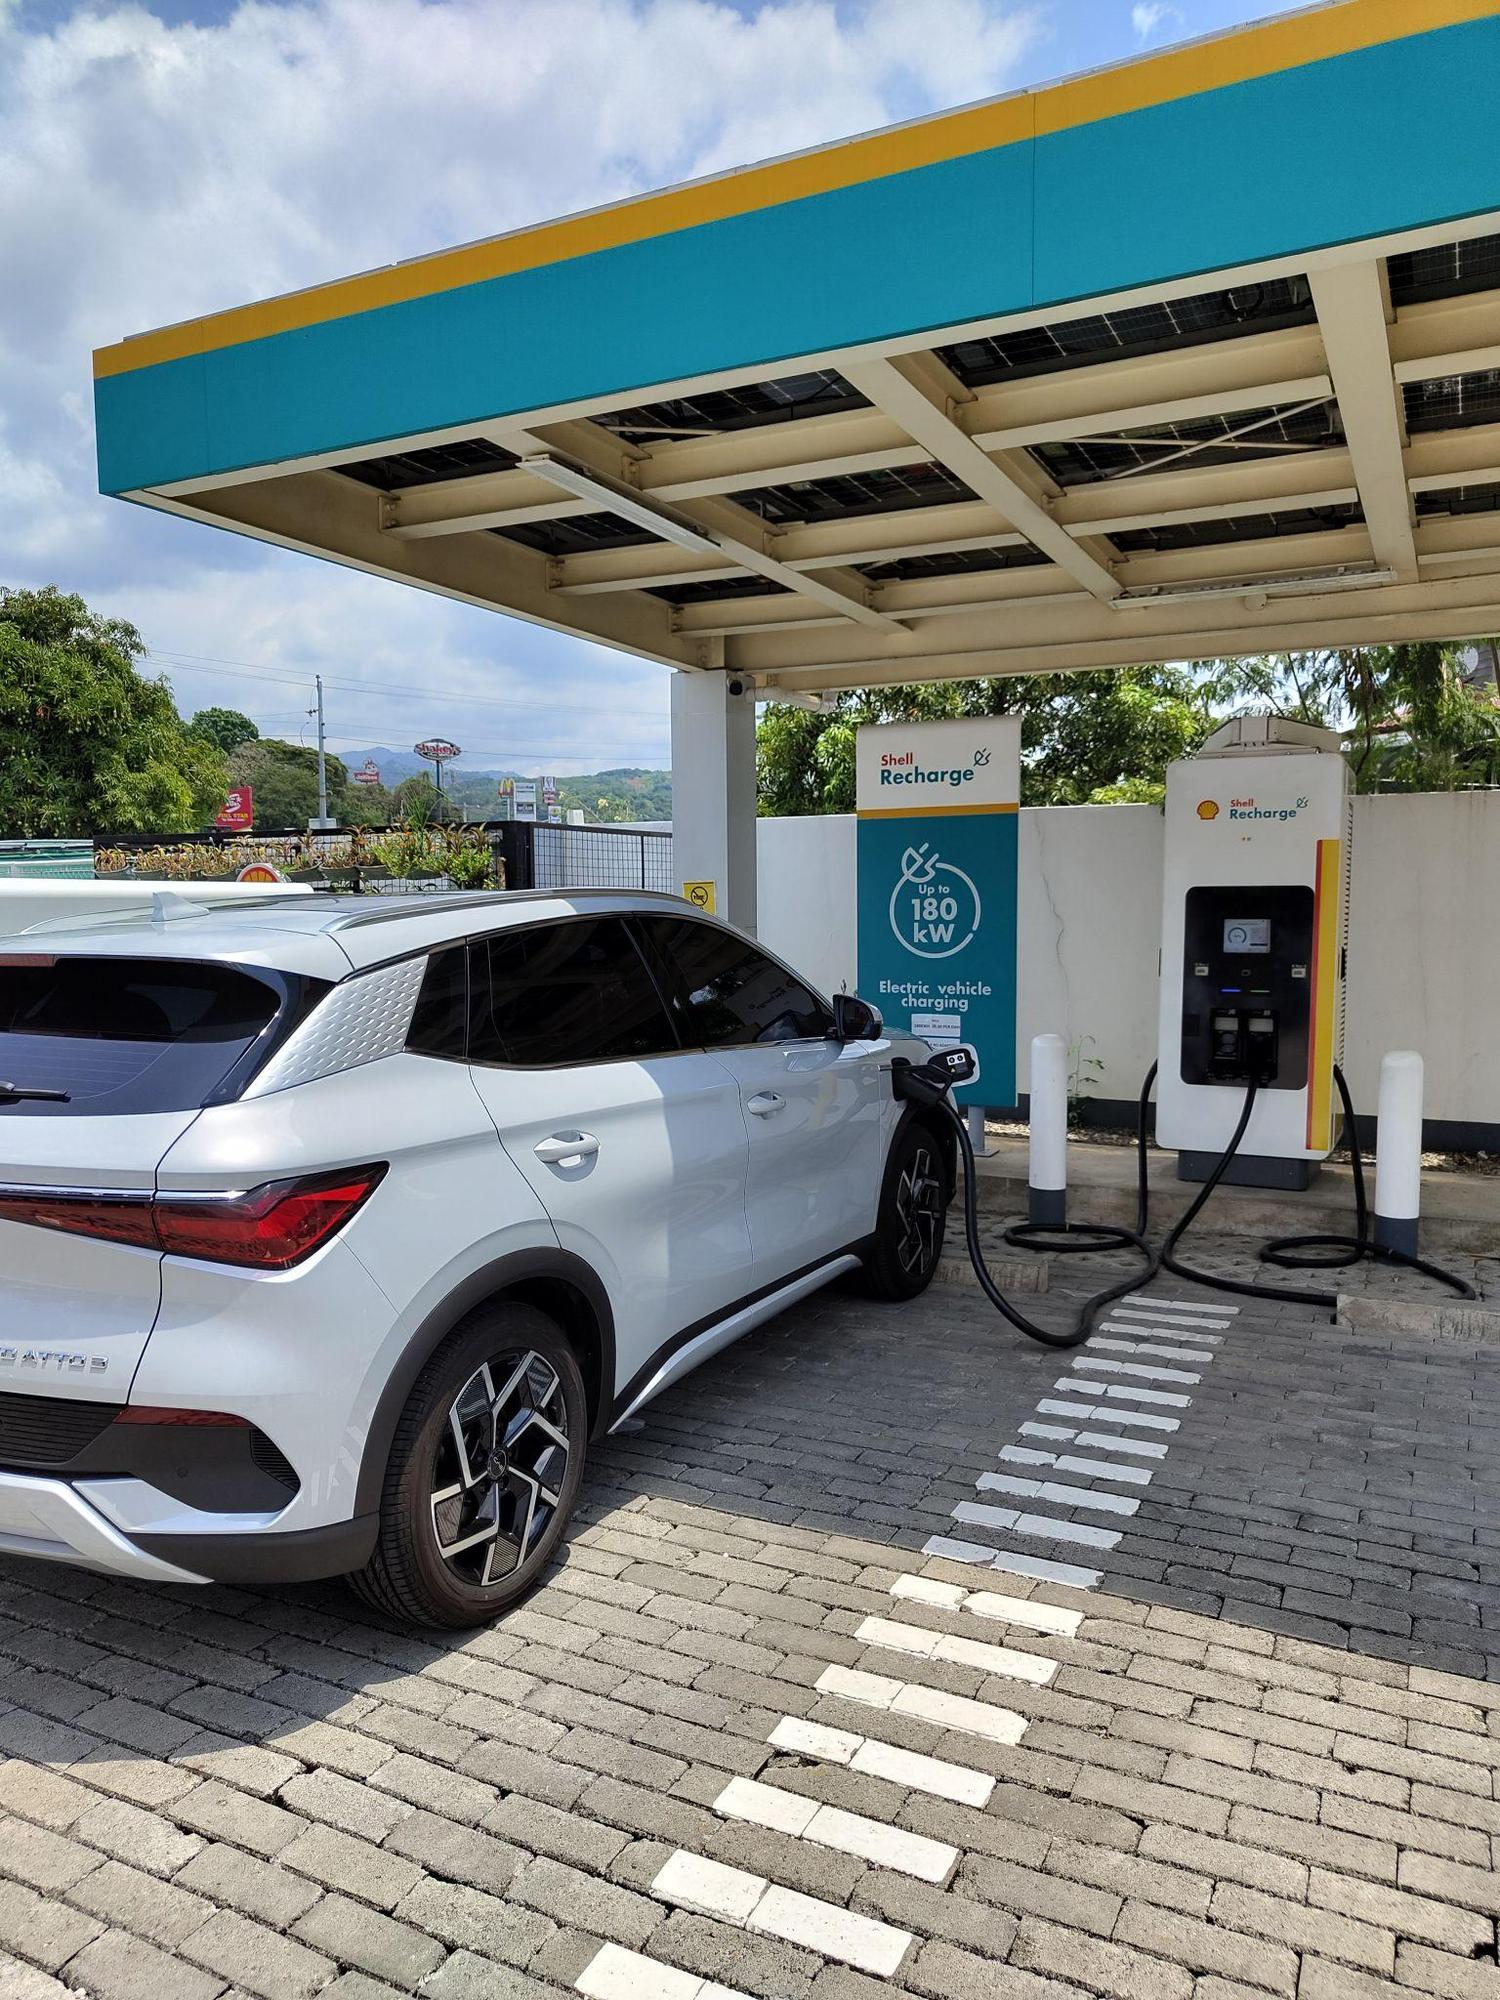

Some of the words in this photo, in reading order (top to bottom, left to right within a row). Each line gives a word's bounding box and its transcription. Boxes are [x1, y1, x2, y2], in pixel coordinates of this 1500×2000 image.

[881, 752, 913, 766] Shell
[880, 766, 974, 787] Recharge
[1230, 799, 1254, 808] Shell
[1230, 807, 1297, 821] Recharge
[918, 884, 935, 897] Up
[938, 884, 950, 894] to
[911, 897, 958, 921] 180
[913, 922, 955, 943] kW
[879, 980, 930, 994] Electric
[938, 980, 992, 995] vehicle
[901, 993, 969, 1012] charging
[21, 1348, 87, 1368] ATTO
